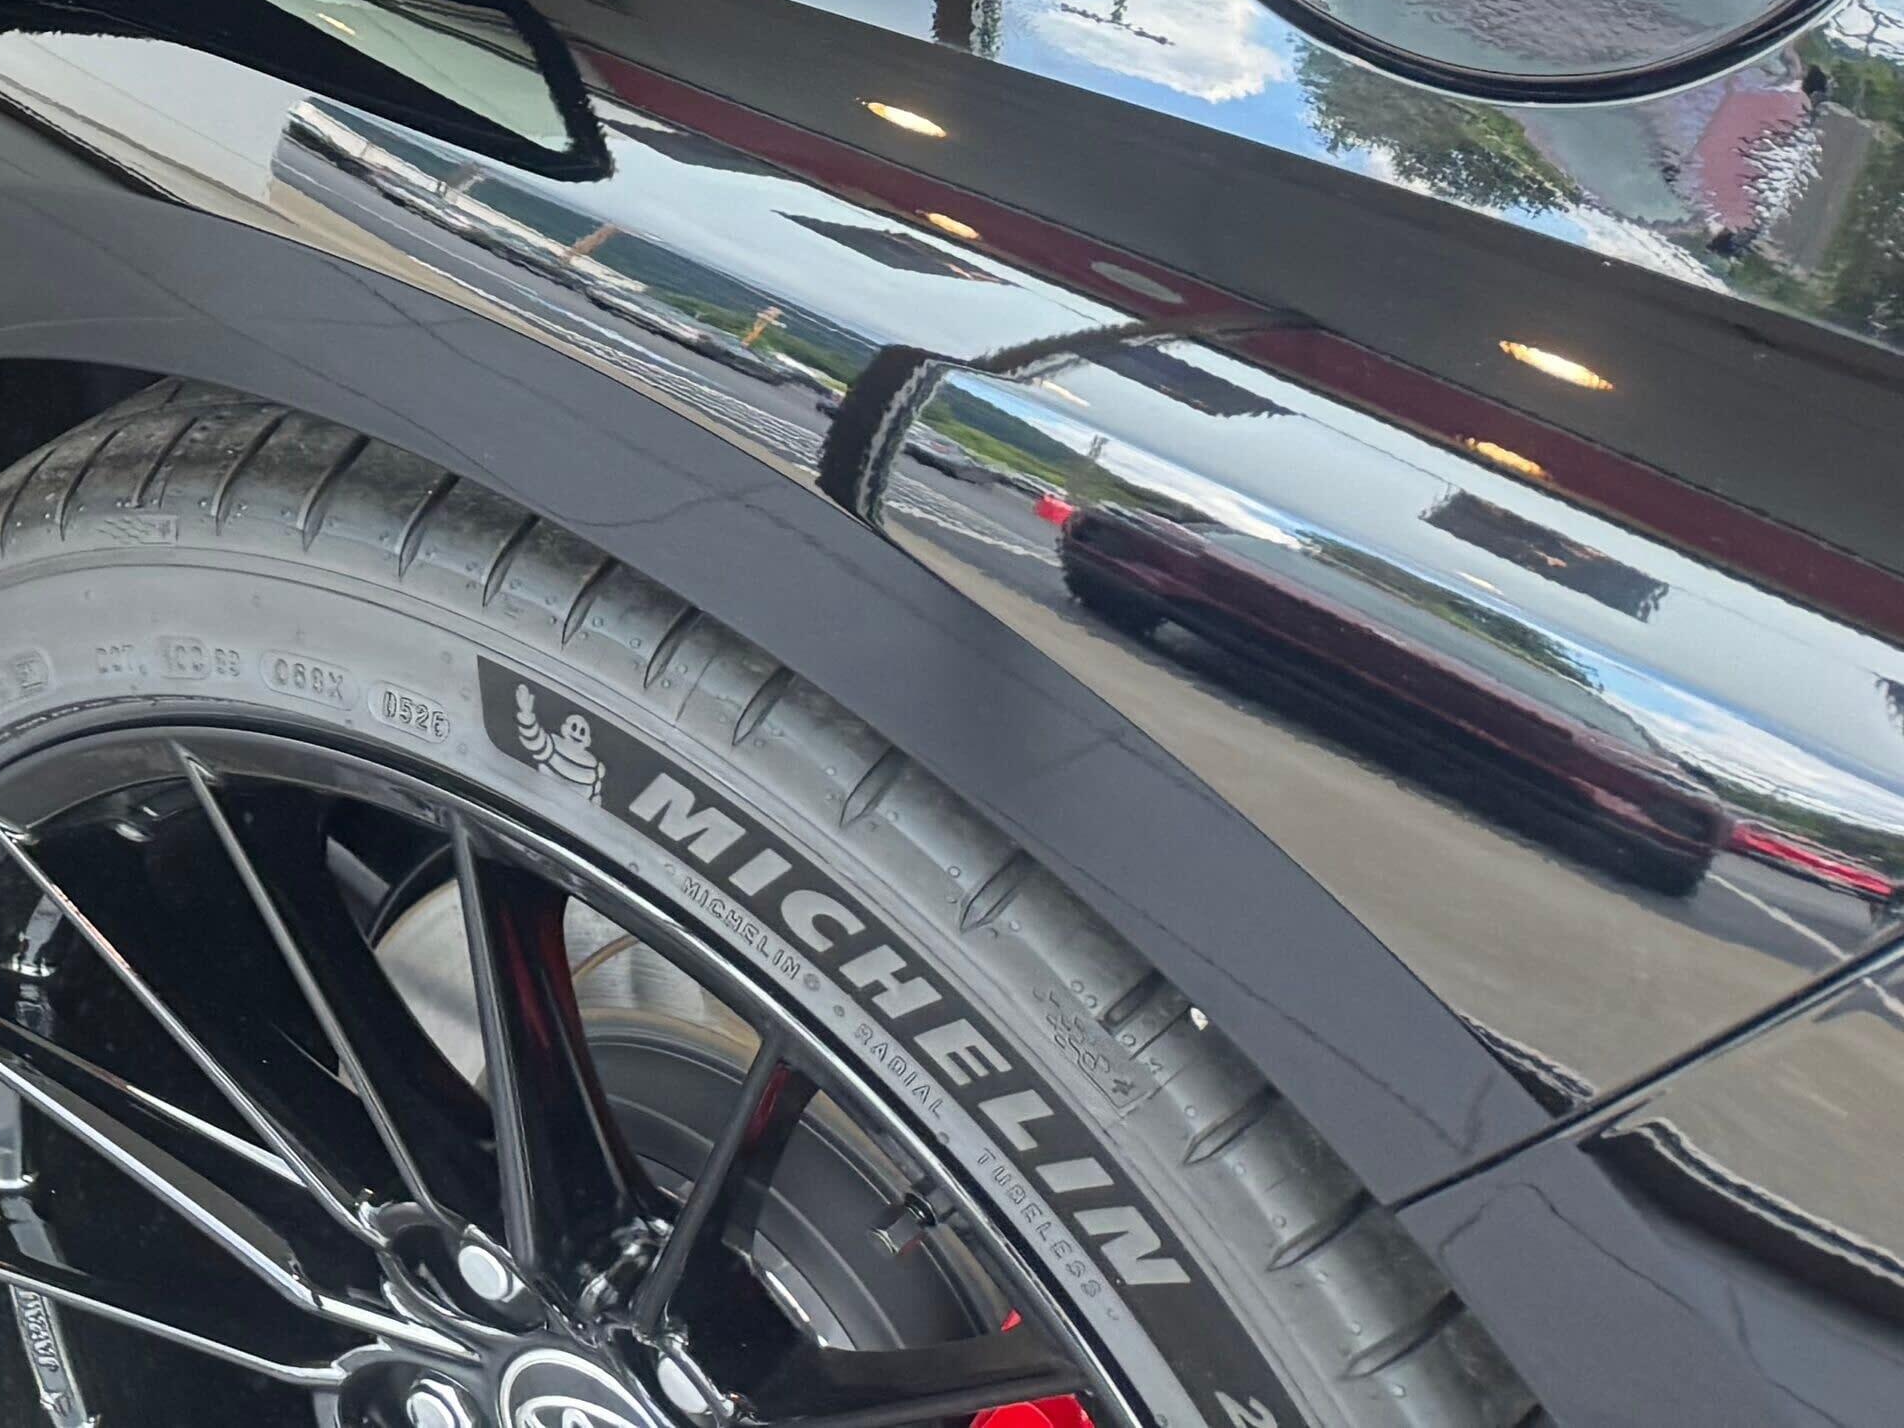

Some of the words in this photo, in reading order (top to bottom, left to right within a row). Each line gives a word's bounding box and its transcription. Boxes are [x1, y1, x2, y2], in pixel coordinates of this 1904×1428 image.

[682, 876, 801, 980] MICHELIN
[629, 772, 1191, 1286] MICHELIN
[854, 1022, 943, 1120] RADIAL
